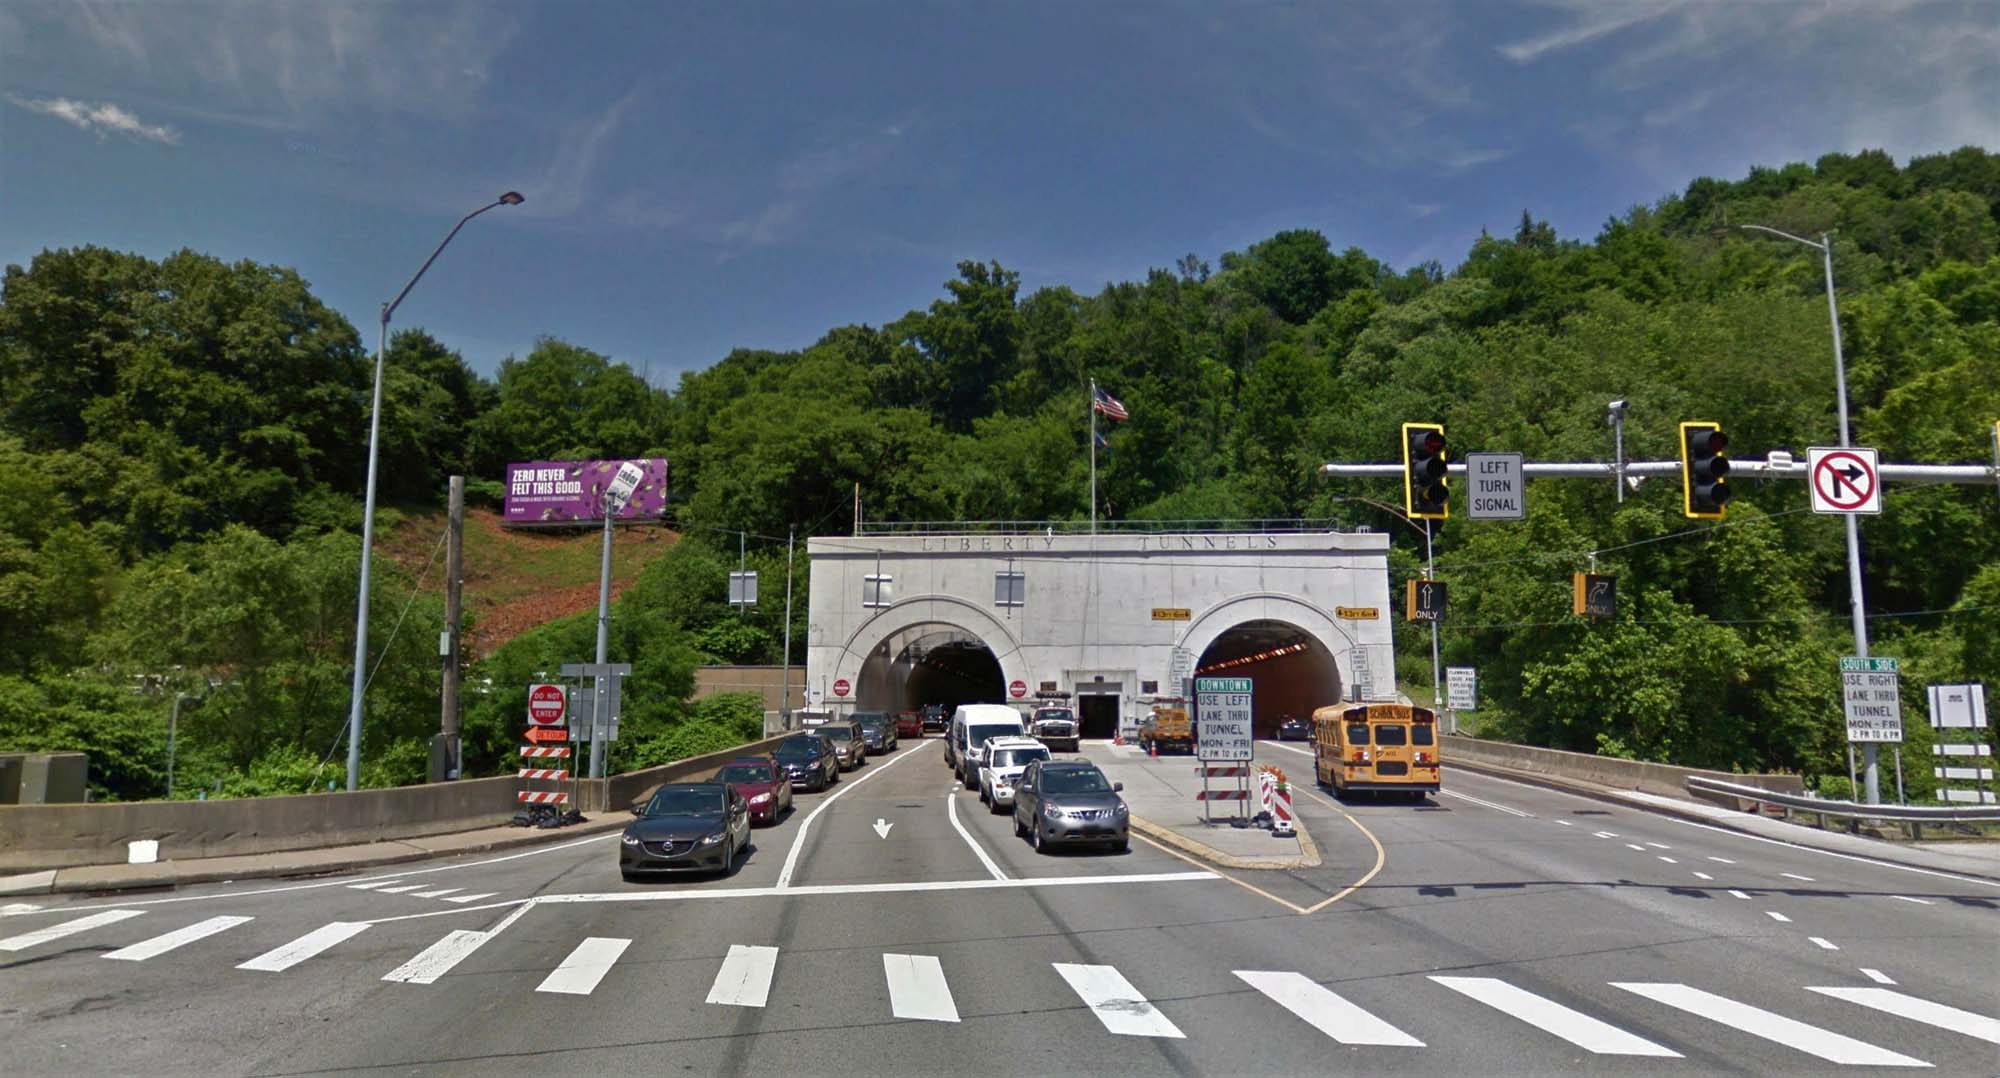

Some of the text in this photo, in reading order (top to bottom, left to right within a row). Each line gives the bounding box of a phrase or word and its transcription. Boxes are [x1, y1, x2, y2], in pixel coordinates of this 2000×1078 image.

[1480, 462, 1509, 474] LEFT
[513, 468, 565, 482] ZERO NEVER
[512, 481, 584, 495] FELT THIS GOOD.
[1479, 480, 1511, 493] TURN
[1475, 499, 1518, 511] SIGNAL
[922, 536, 1277, 551] LIBERTY TUNNELS
[1416, 611, 1438, 619] ONLY
[1842, 660, 1896, 670] SOUTH SIDE
[1201, 680, 1248, 690] DOWNTOWN
[1844, 675, 1896, 685] USE RIGHT
[534, 692, 560, 700] DO NOT
[1848, 690, 1896, 701] LANE THRU
[1200, 696, 1250, 706] USE LEFT
[1201, 711, 1248, 721] LANE THRU
[1853, 706, 1892, 716] TUNNEL
[1849, 720, 1871, 728] MON
[1882, 720, 1899, 728] FRI
[1205, 724, 1243, 735] TUNNEL
[1860, 730, 1869, 738] PM
[1872, 730, 1880, 738] TO
[536, 731, 566, 739] DETOUR
[1201, 739, 1223, 747] MON
[1233, 739, 1249, 747] FRI
